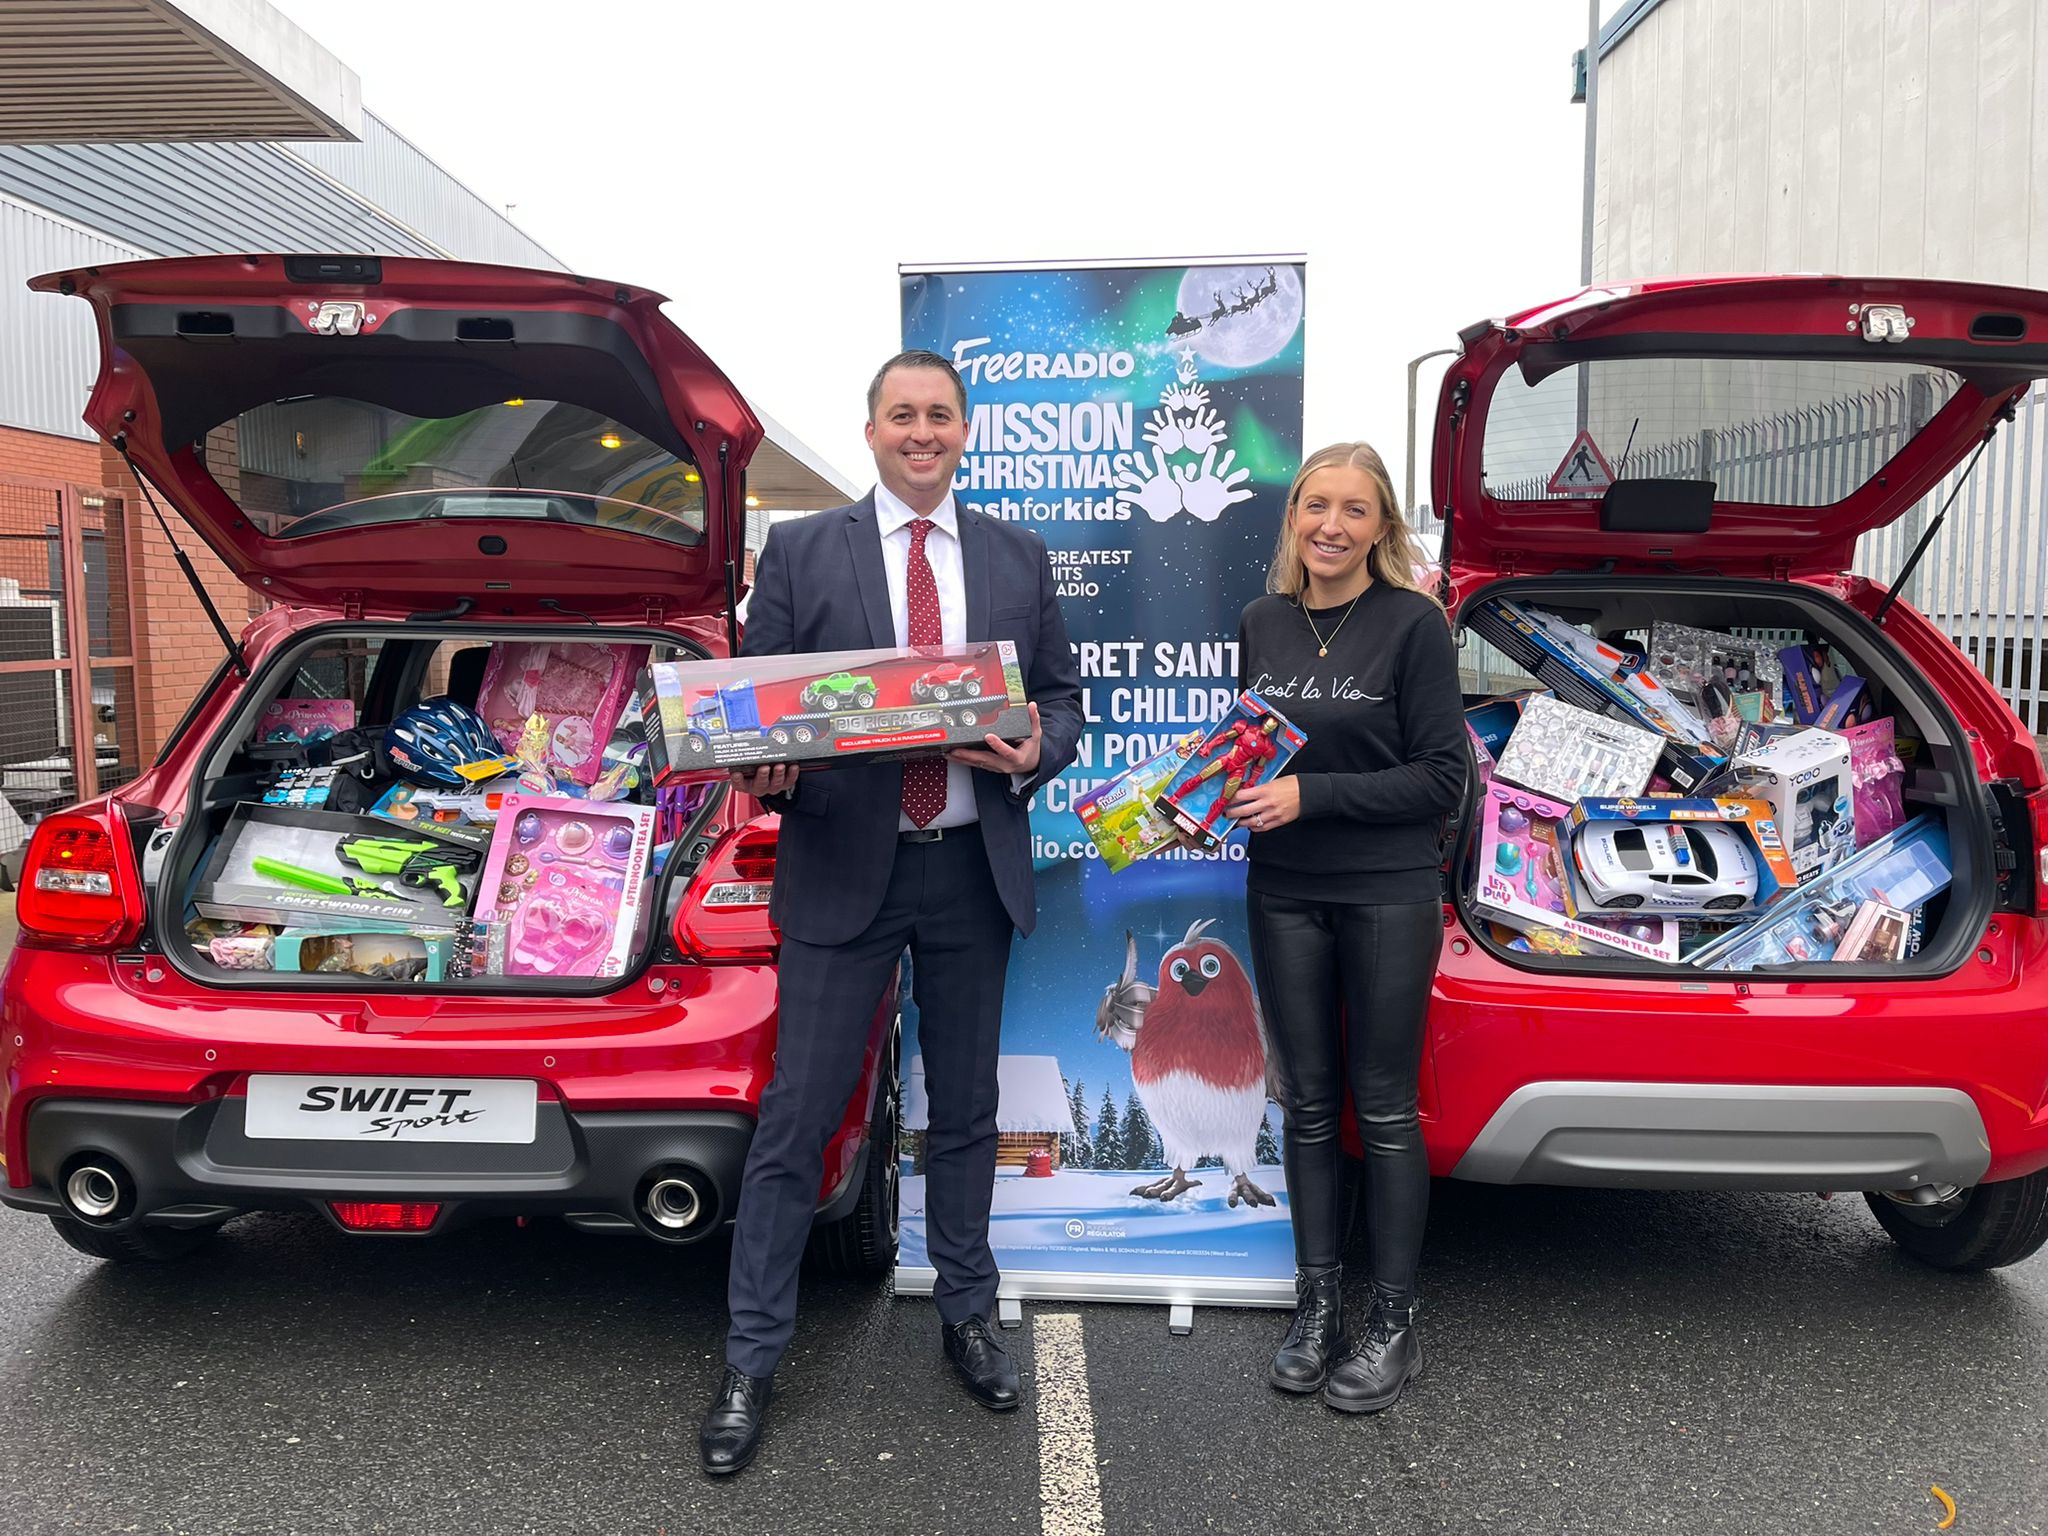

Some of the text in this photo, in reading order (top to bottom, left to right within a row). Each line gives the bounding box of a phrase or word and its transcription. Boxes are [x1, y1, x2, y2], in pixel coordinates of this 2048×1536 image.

[952, 337, 1135, 385] Free RADIO
[965, 402, 1133, 452] MISSION
[951, 453, 1133, 490] CHRISTMAS
[1047, 550, 1132, 565] GREATEST
[1055, 582, 1100, 597] ADIO
[1154, 641, 1240, 678] SANT
[1250, 673, 1384, 700] C'est la Vie
[287, 709, 328, 719] Princess
[1111, 688, 1239, 723] CHILDR
[837, 711, 937, 731] BIG RIG RACER
[1789, 768, 1820, 786] YCOO
[640, 812, 651, 828] SET
[1082, 805, 1096, 818] LEGO
[419, 822, 434, 831] TRY
[1174, 813, 1199, 835] MARVEL
[637, 829, 648, 846] TEA
[1600, 838, 1615, 866] POLICE
[626, 847, 644, 907] AFTERNOON
[567, 887, 604, 906] Princess
[1483, 886, 1511, 904] PLAY
[273, 896, 413, 917] SPACE SWORD & GUN
[1563, 921, 1671, 960] AFTERNOON TEA SET
[299, 1086, 471, 1113] SWIFT
